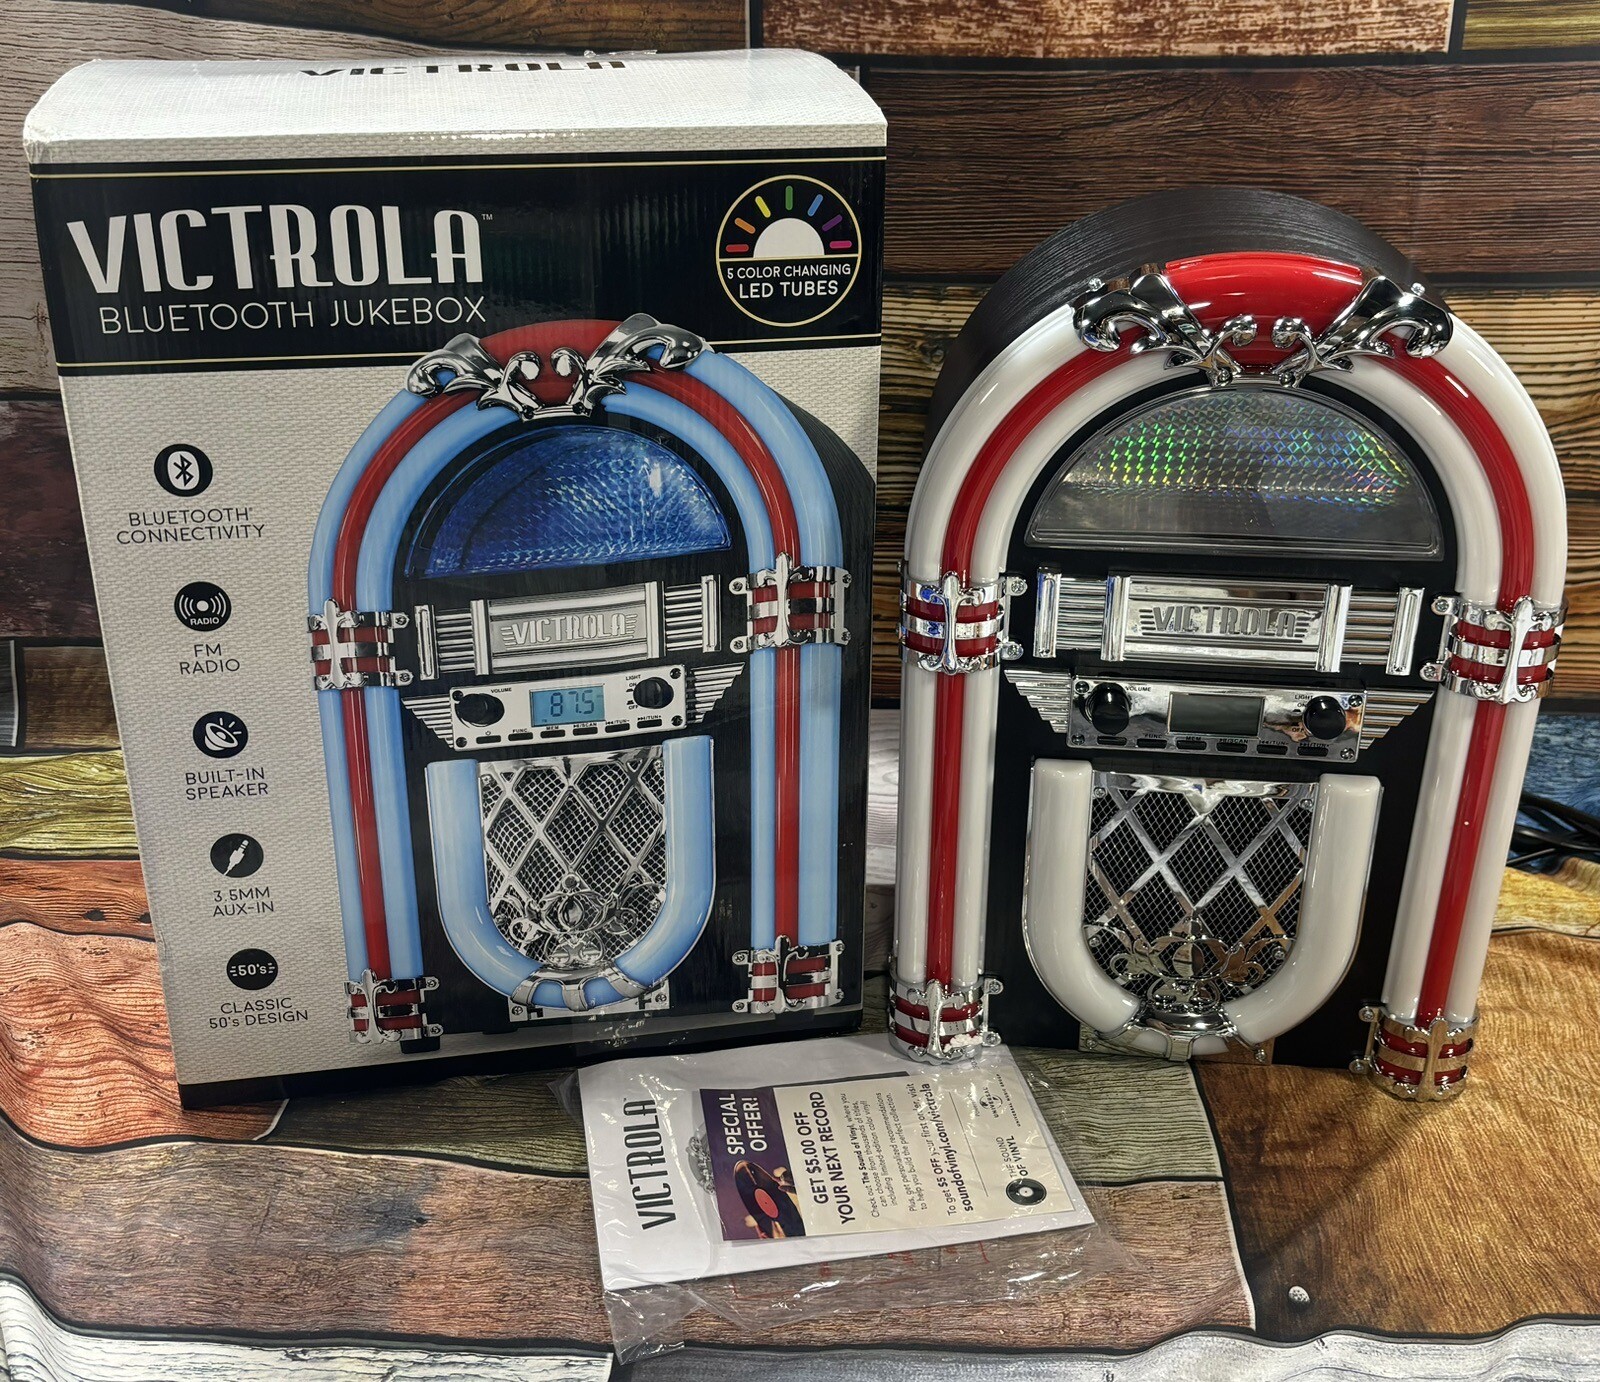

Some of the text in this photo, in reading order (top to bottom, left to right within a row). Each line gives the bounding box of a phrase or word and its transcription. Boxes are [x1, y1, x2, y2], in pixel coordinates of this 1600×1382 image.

[66, 204, 483, 293] VICTROLA
[727, 264, 851, 279] 5 COLOR CHANGING
[739, 280, 838, 299] LED TUBES
[99, 295, 486, 334] BLUETOOTH JUKEBOX
[117, 524, 265, 544] CONNECTIVITY
[190, 616, 220, 626] RADIO
[510, 613, 627, 645] VICTROLA
[1153, 605, 1296, 638] VICTROLA
[194, 643, 222, 657] FM
[179, 659, 240, 675] RADIO
[551, 689, 594, 717] 87.5
[185, 767, 265, 786] BUILT-IN
[186, 782, 269, 801] SPEAKER
[213, 887, 271, 902] 3.5MM
[213, 901, 274, 917] AUX-IN
[238, 963, 267, 976] 50's
[220, 997, 292, 1015] CLASSIC
[209, 1010, 308, 1029] 50's DESIGN
[840, 1093, 850, 1104] you
[906, 1083, 917, 1098] visit
[983, 1087, 999, 1118] UNIVERSAL
[843, 1105, 852, 1122] where
[875, 1092, 895, 1143] recommendations
[719, 1094, 745, 1155] SPECIAL
[741, 1098, 767, 1151] OFFER!
[846, 1124, 858, 1141] Vinyl,
[866, 1116, 875, 1131] color
[920, 1122, 931, 1137] first
[858, 1124, 872, 1155] thousands
[894, 1123, 909, 1144] perfect
[902, 1146, 910, 1156] the
[921, 1083, 974, 1211] soundofvinyl.com/victrola
[1006, 1135, 1028, 1176] OF VINYL
[623, 1099, 677, 1230] VICTROLA
[793, 1112, 829, 1204] GET $5.00 OFF
[809, 1092, 855, 1224] YOUR NEXT RECORD
[854, 1150, 867, 1170] Sound
[868, 1156, 877, 1170] from
[889, 1144, 911, 1183] personalized
[904, 1157, 916, 1173] build
[930, 1158, 943, 1175] OFF
[995, 1137, 1017, 1178] THE SOUND
[861, 1172, 870, 1184] The
[872, 1172, 884, 1194] choose
[912, 1174, 922, 1186] you
[936, 1177, 948, 1187] $5
[865, 1185, 874, 1196] out
[884, 1177, 898, 1206] including
[903, 1184, 915, 1195] get
[914, 1187, 925, 1201] help
[942, 1189, 956, 1203] get
[868, 1197, 880, 1218] Check
[879, 1196, 888, 1207] can
[947, 1205, 957, 1216] To
